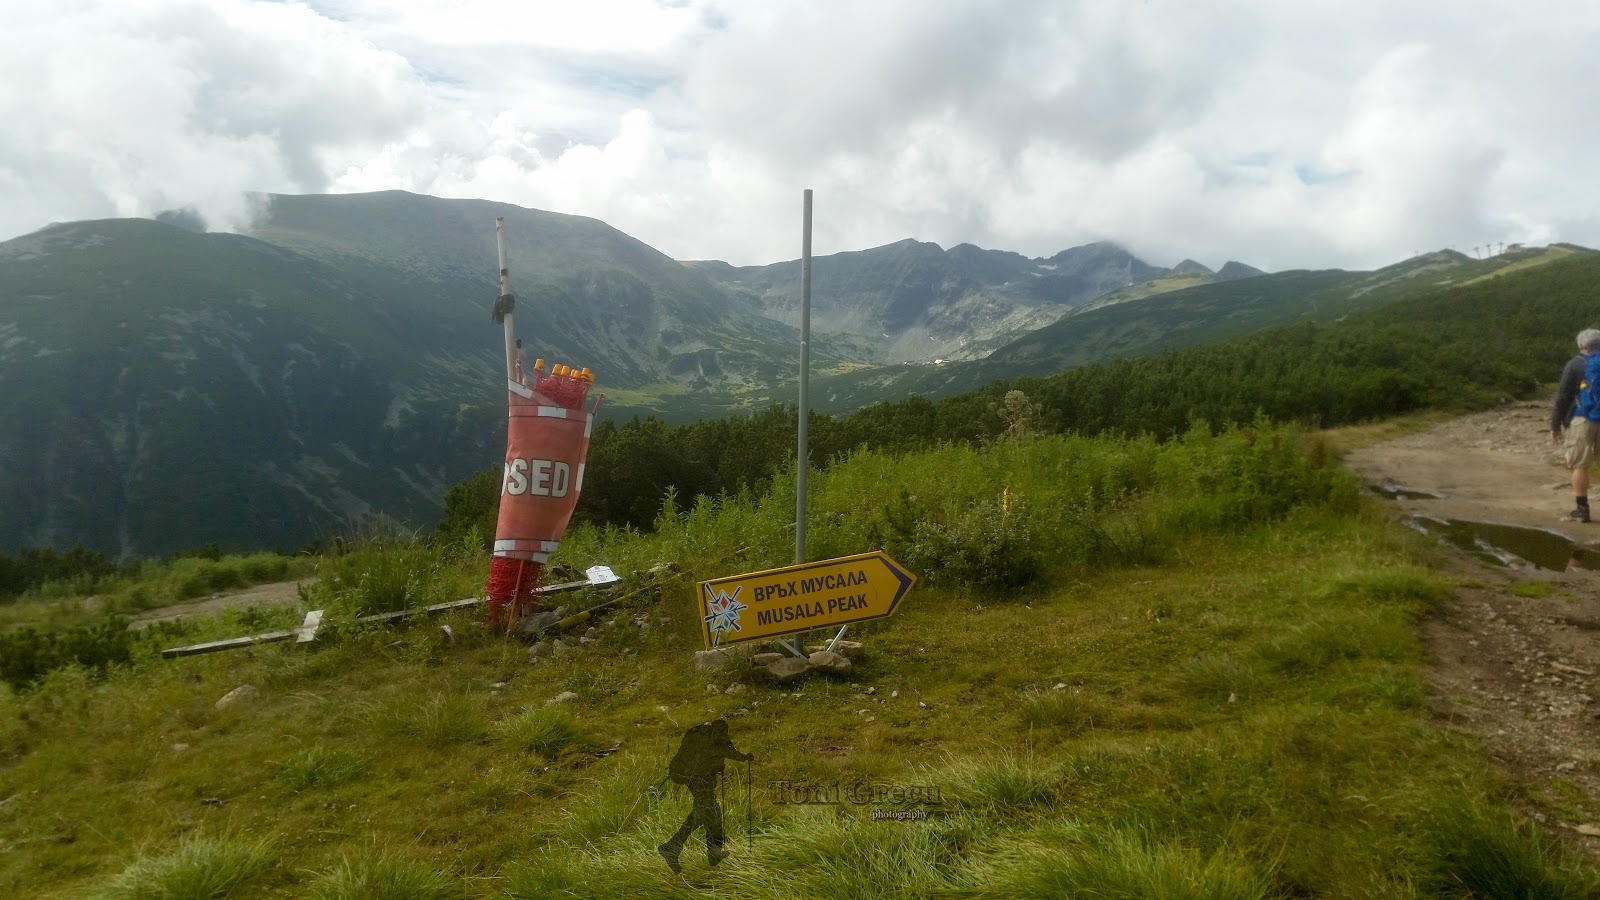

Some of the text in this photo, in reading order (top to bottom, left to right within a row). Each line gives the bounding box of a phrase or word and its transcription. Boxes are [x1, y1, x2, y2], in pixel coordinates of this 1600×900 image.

[753, 570, 868, 602] ВРЪХ МУСАЛА
[758, 594, 869, 626] MUSALA PEAK
